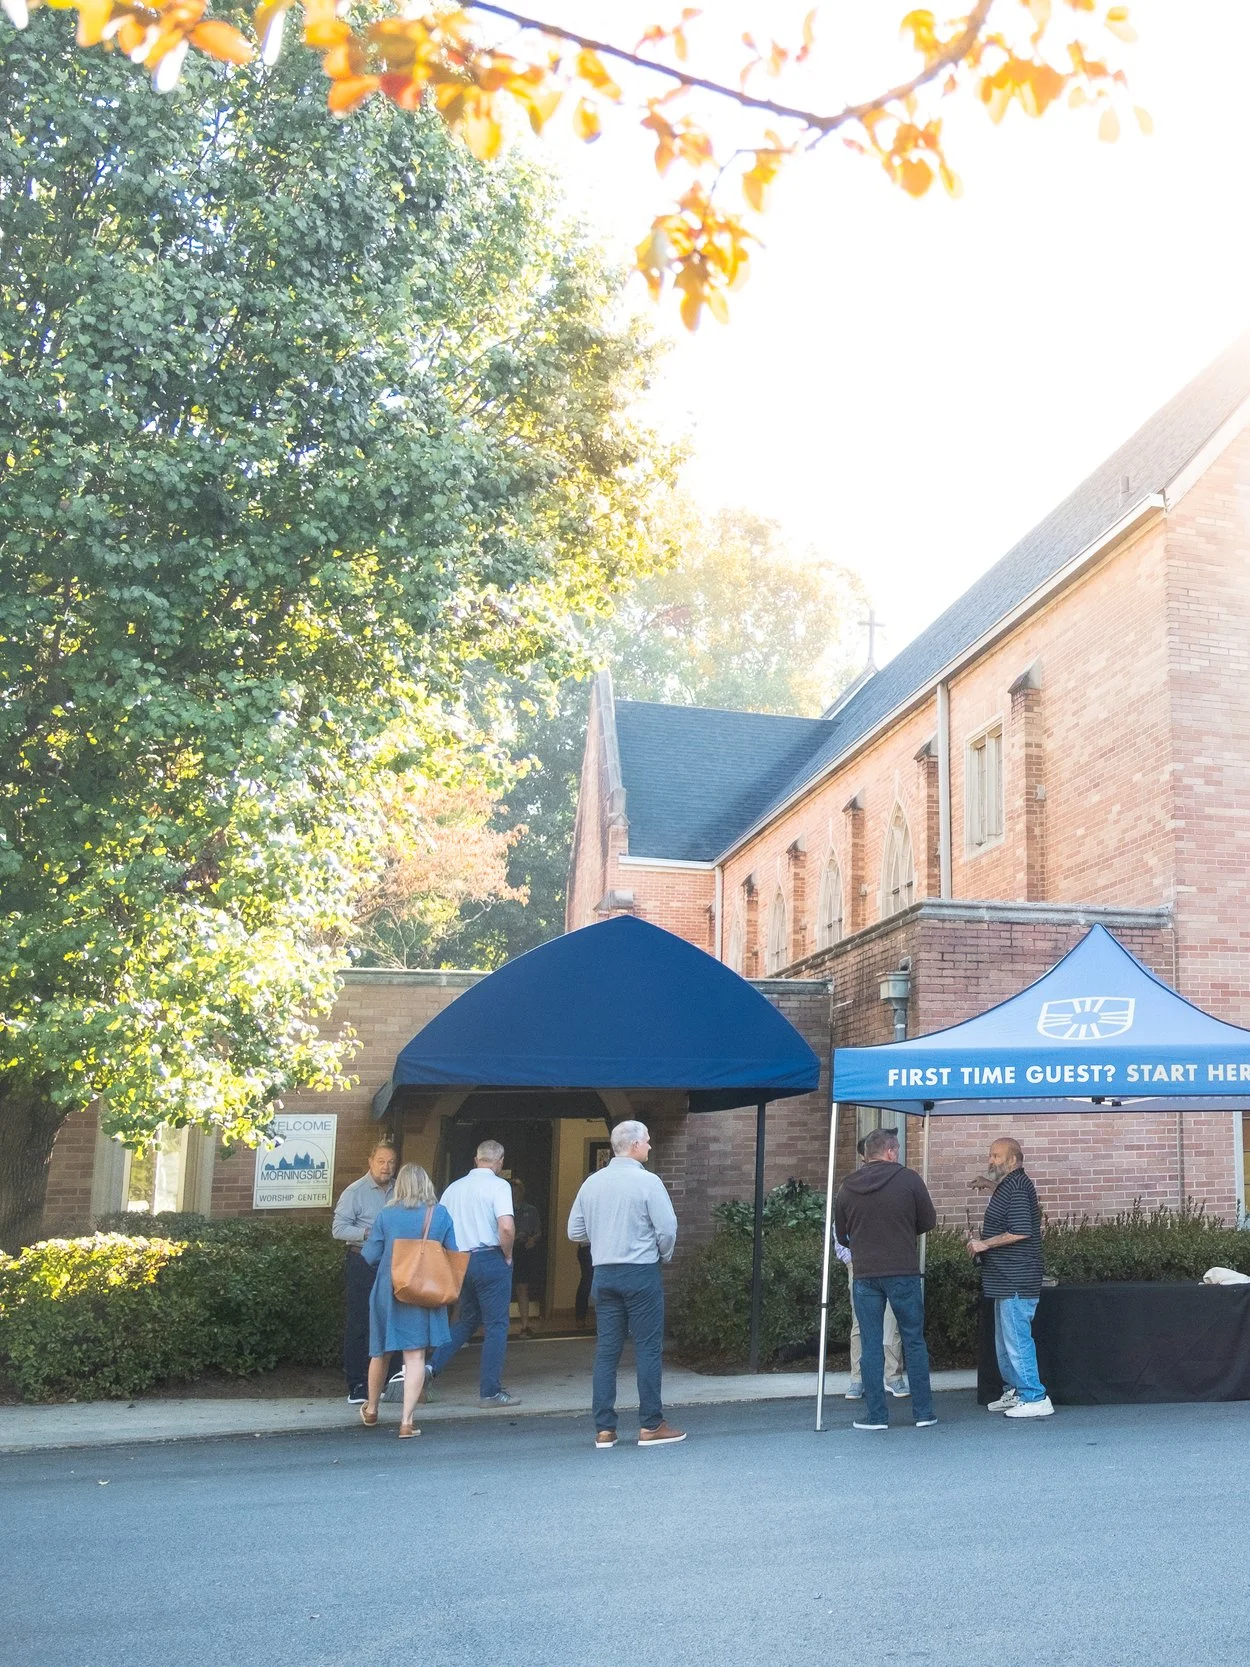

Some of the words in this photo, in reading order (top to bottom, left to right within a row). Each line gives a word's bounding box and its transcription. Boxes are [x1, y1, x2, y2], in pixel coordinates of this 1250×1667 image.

[888, 1068, 952, 1087] FIRST
[960, 1066, 1016, 1085] TIME
[1025, 1064, 1116, 1083] GUEST?
[1126, 1064, 1198, 1082] START
[260, 1169, 328, 1180] MORNINGSIDE
[259, 1194, 295, 1202] WORSHIP
[297, 1193, 327, 1201] CENTER
